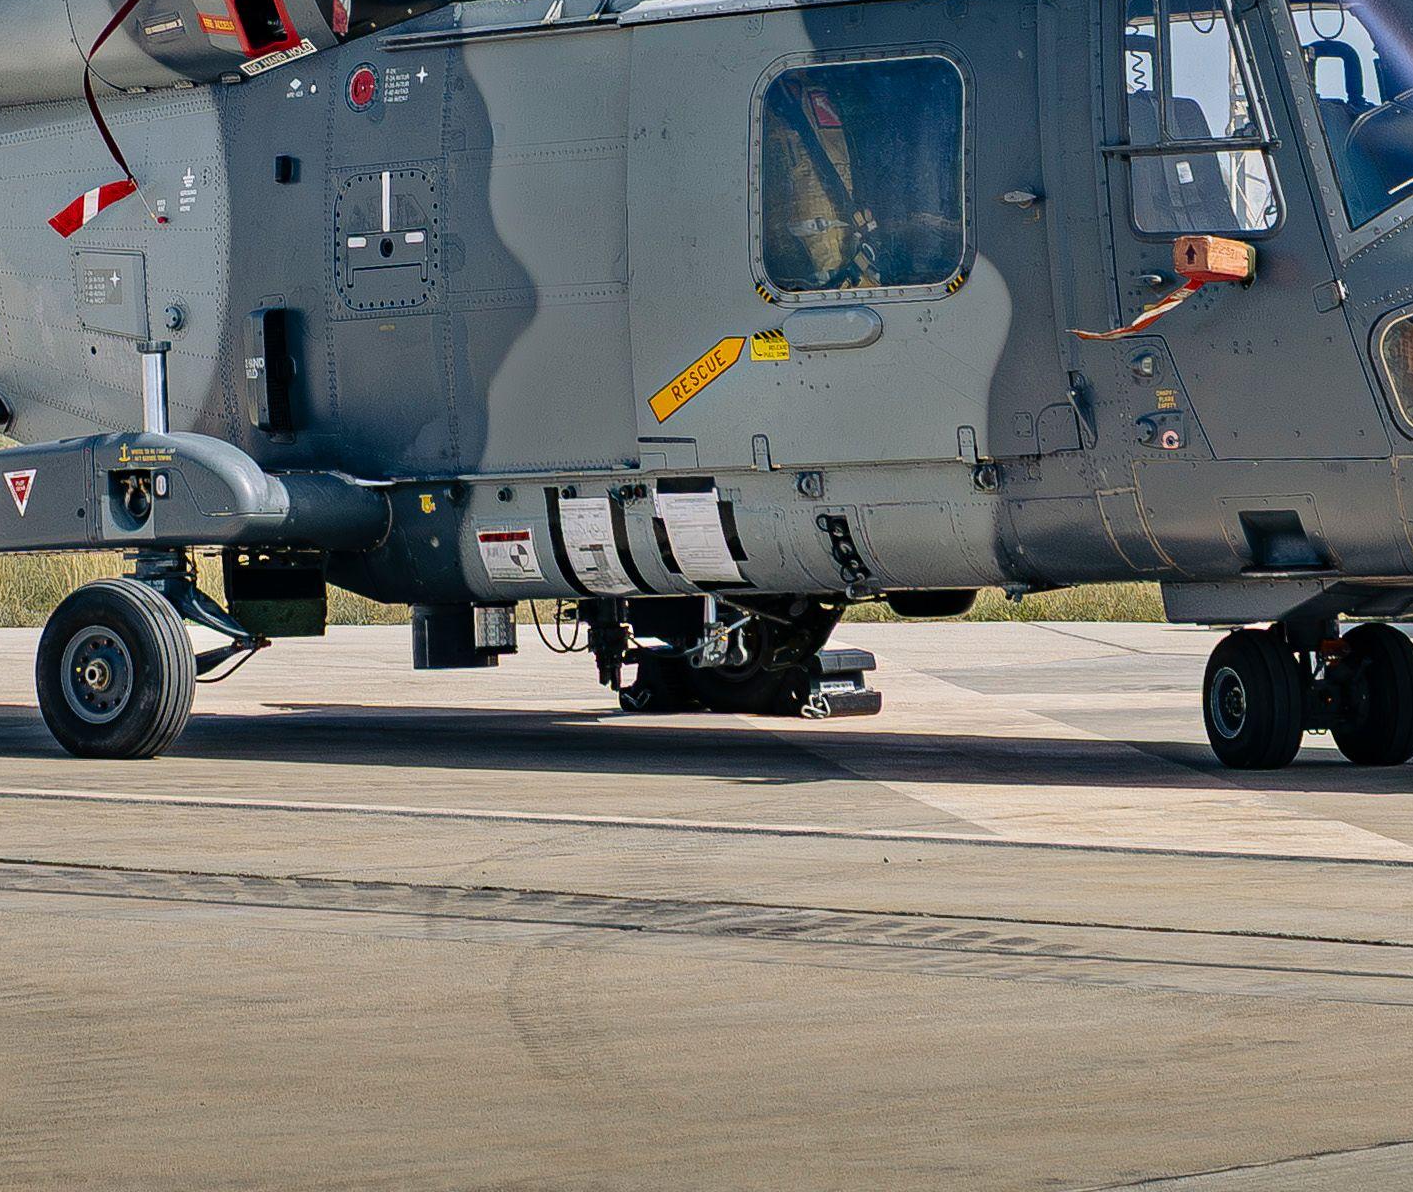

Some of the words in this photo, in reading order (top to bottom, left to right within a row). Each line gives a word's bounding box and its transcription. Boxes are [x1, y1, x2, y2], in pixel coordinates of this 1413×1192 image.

[246, 62, 262, 73] NO
[260, 52, 287, 69] HAND
[285, 41, 312, 58] HOLD
[670, 349, 727, 402] RESCUE
